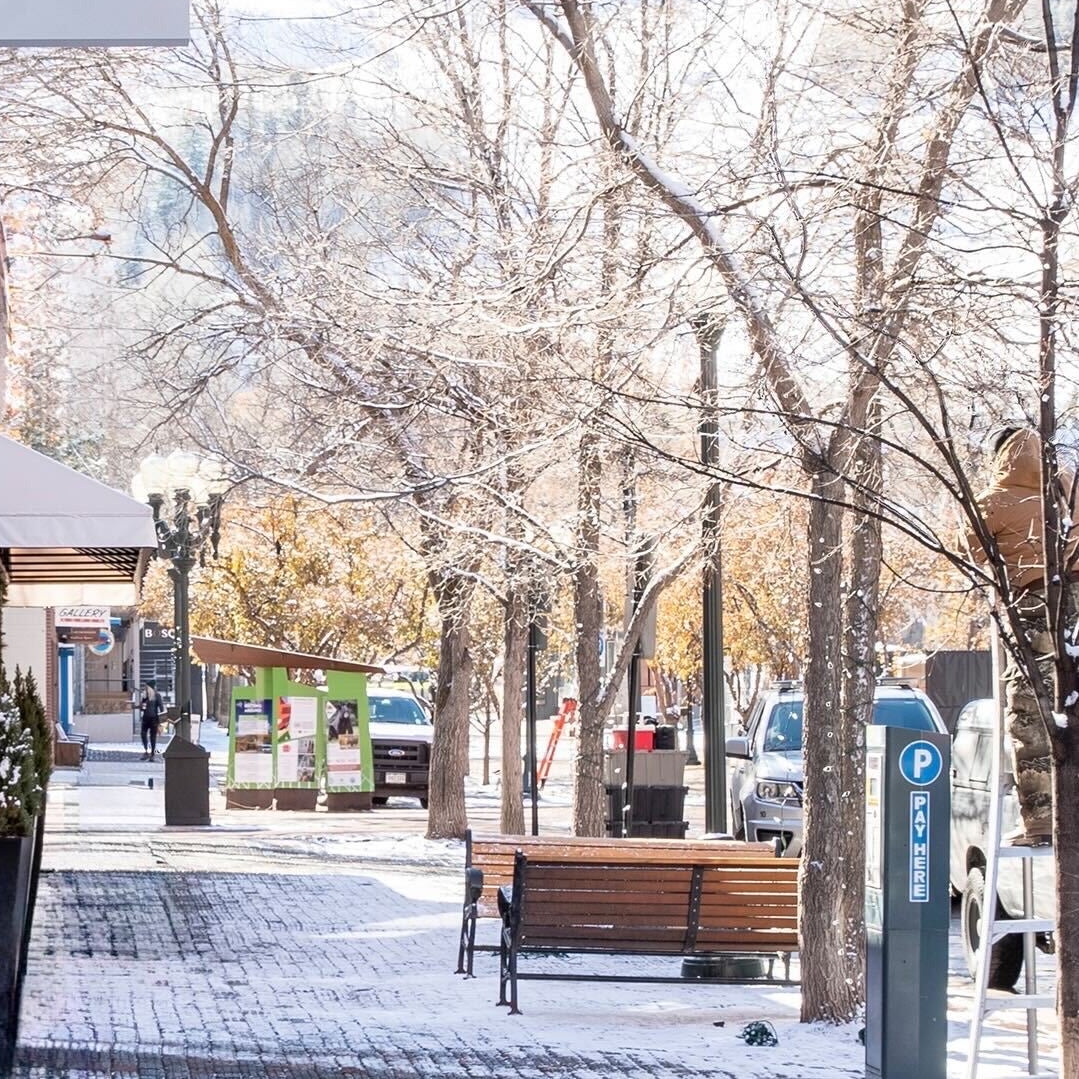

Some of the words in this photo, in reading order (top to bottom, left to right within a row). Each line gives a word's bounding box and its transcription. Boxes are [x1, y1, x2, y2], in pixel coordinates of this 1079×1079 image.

[60, 608, 106, 617] GALLERY
[913, 749, 933, 778] P
[914, 796, 926, 837] PAY
[913, 843, 926, 897] HERE
